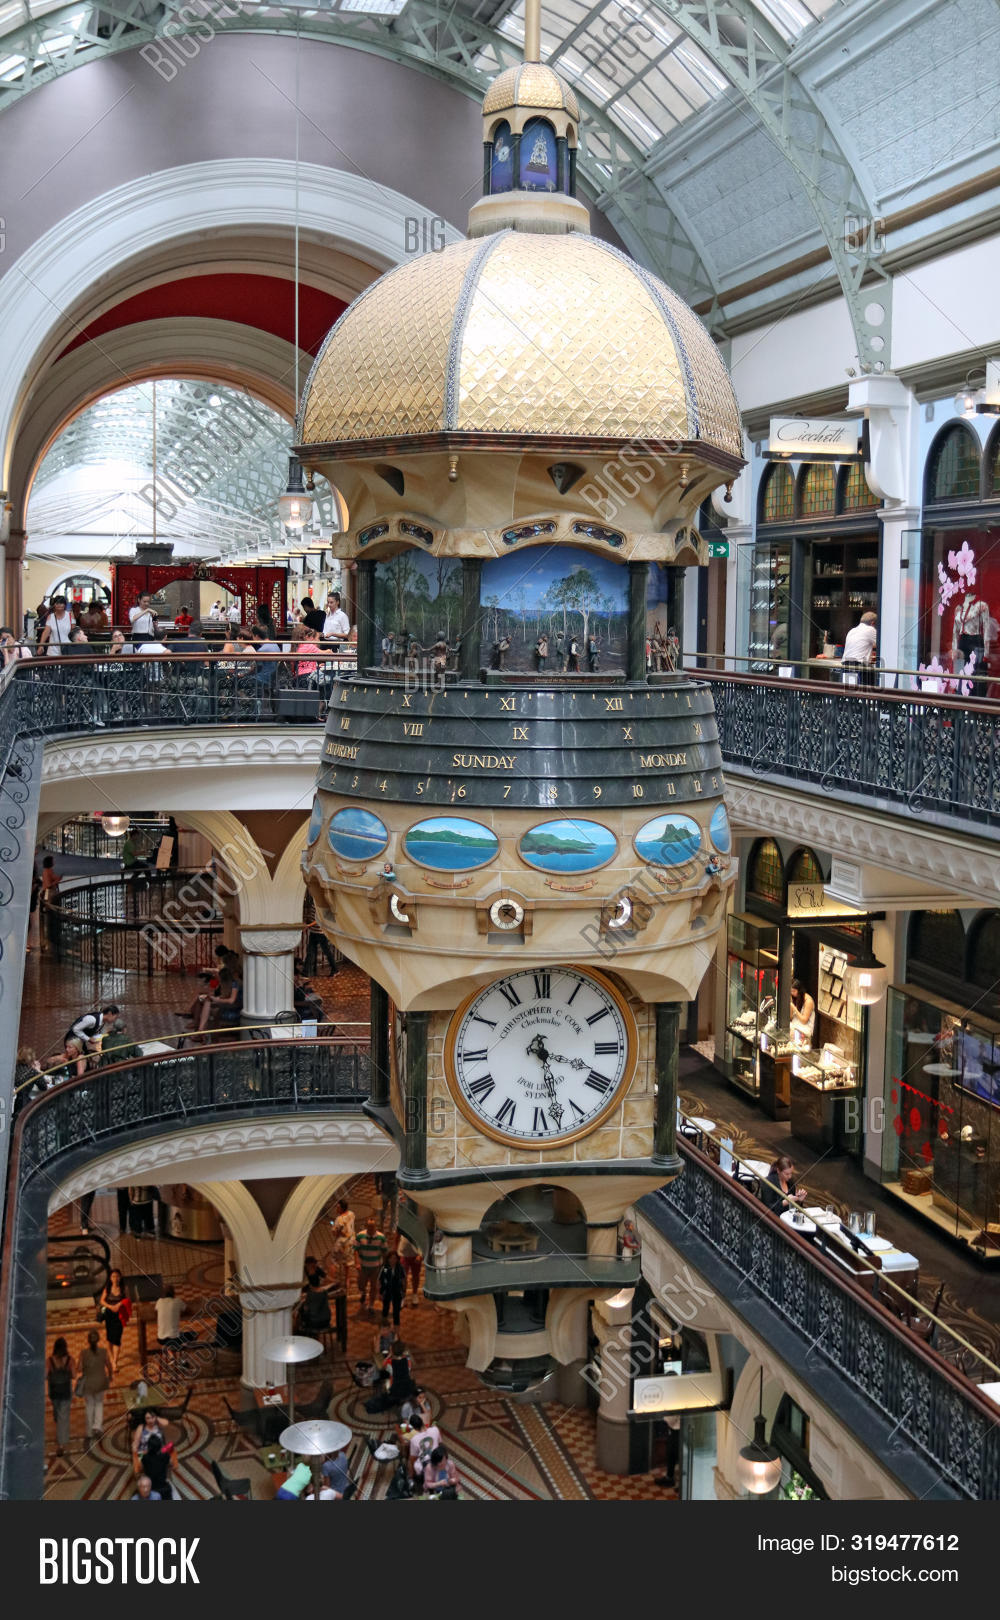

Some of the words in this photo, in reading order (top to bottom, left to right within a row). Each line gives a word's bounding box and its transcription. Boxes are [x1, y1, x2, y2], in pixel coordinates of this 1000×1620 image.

[401, 694, 412, 708] X
[500, 697, 517, 711] XI
[605, 697, 624, 711] XII
[402, 722, 425, 737] VIII
[512, 727, 530, 741] IX
[622, 727, 633, 741] X
[452, 753, 518, 769] SUNDAY
[640, 752, 688, 768] MONDAY
[351, 775, 359, 789] 3
[379, 779, 388, 793] 4
[415, 781, 424, 795] 5
[457, 785, 466, 798] 6
[503, 785, 511, 799] 7
[550, 785, 558, 799] 8
[593, 785, 602, 799] 9
[632, 784, 644, 798] 10
[667, 782, 676, 796] 11
[499, 982, 522, 1011] XI
[533, 974, 551, 999] XII
[500, 1006, 552, 1039] CHRISTOPHER
[564, 1014, 583, 1035] COOK
[521, 1017, 562, 1030] Clockmaker
[585, 1007, 611, 1028] II
[594, 1040, 618, 1056] III
[533, 1107, 548, 1131] VI
